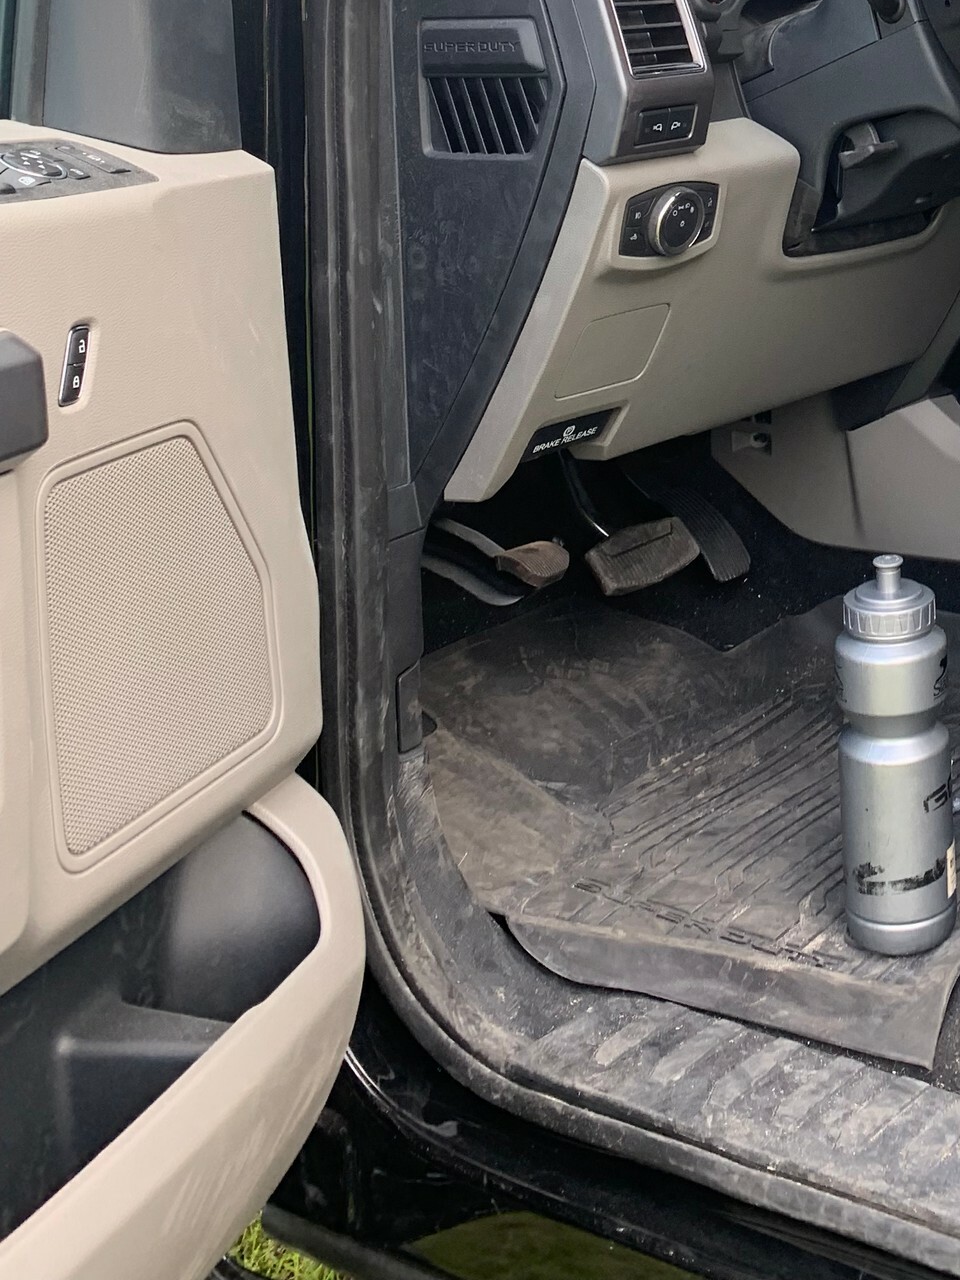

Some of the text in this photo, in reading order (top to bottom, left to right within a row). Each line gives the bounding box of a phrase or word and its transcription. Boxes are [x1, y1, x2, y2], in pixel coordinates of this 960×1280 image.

[424, 41, 519, 53] SUPER DUTY
[532, 426, 598, 453] BRAKE RELEASE
